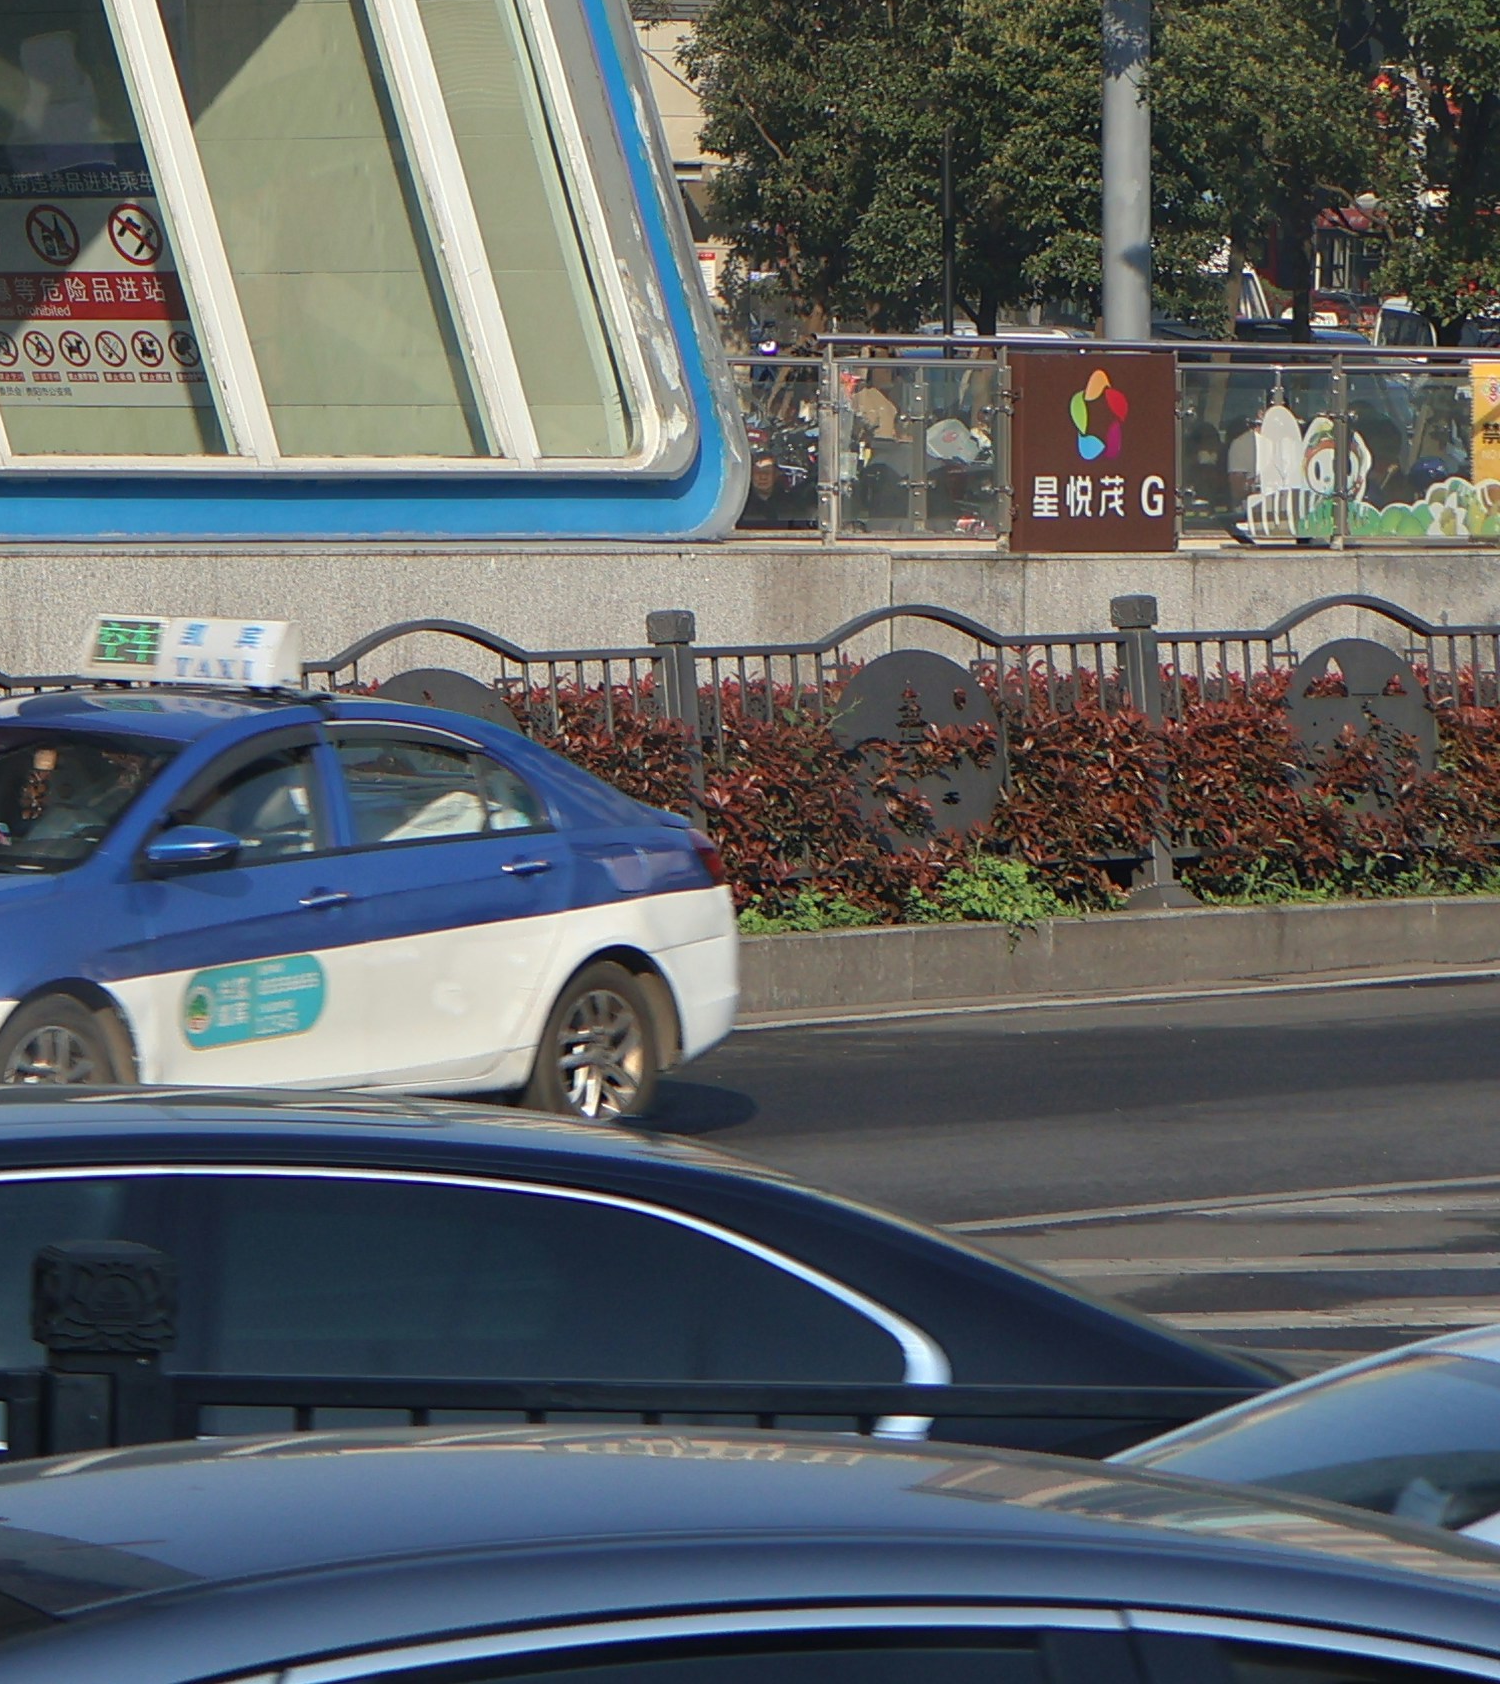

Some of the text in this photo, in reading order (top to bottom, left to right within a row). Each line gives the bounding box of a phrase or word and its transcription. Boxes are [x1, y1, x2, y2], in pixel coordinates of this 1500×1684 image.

[1032, 476, 1164, 518] 星悦茂 G
